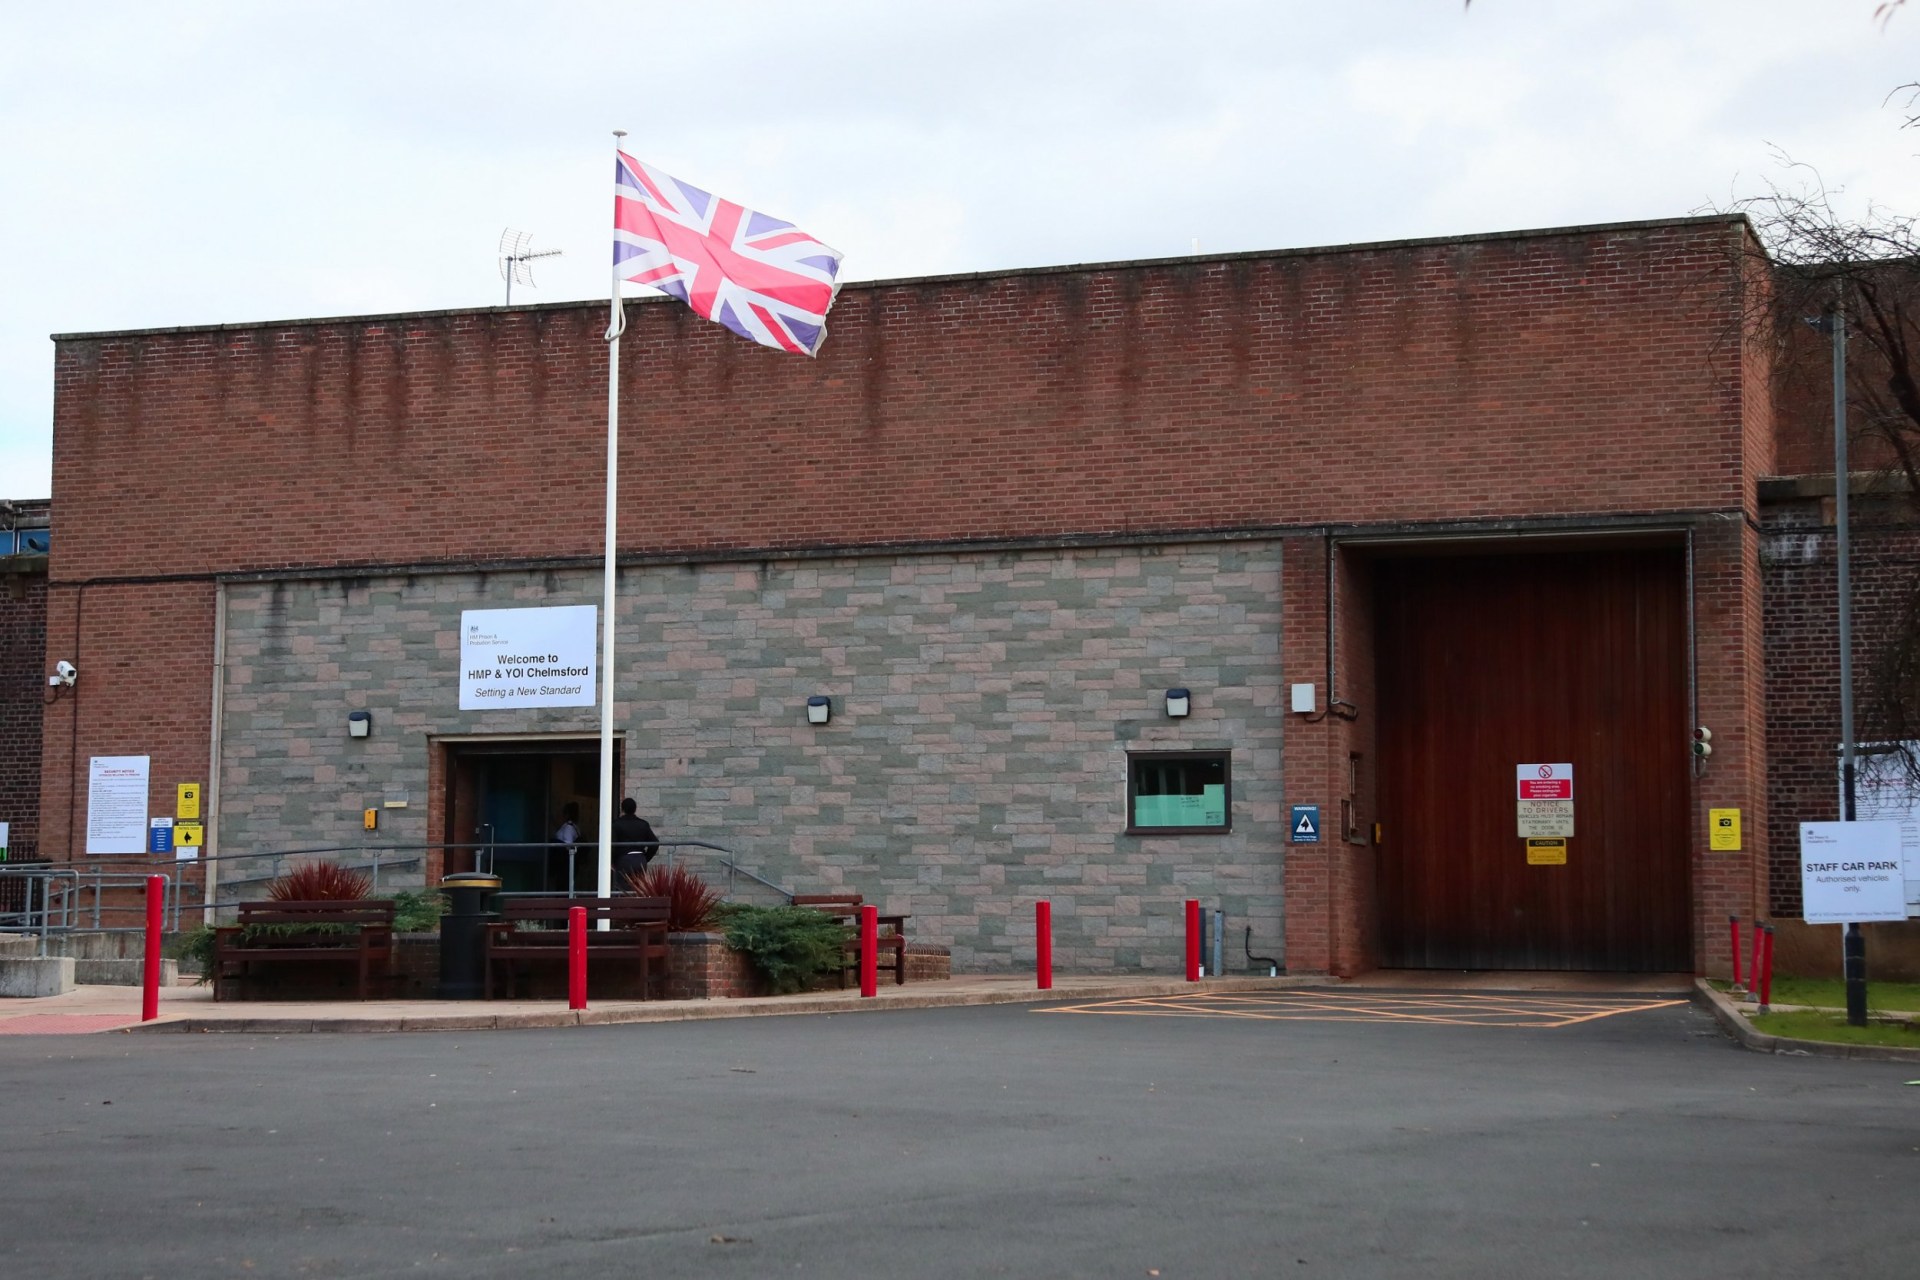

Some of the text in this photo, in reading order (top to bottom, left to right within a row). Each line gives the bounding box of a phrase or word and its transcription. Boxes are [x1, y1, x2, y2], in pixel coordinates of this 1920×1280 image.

[498, 654, 558, 664] Welcome to
[468, 666, 588, 680] HMP & YOI Chelmsford
[475, 688, 506, 698] Setting
[517, 686, 538, 696] New
[540, 684, 581, 696] Standard
[1806, 861, 1898, 872] STAFF CAR PARK
